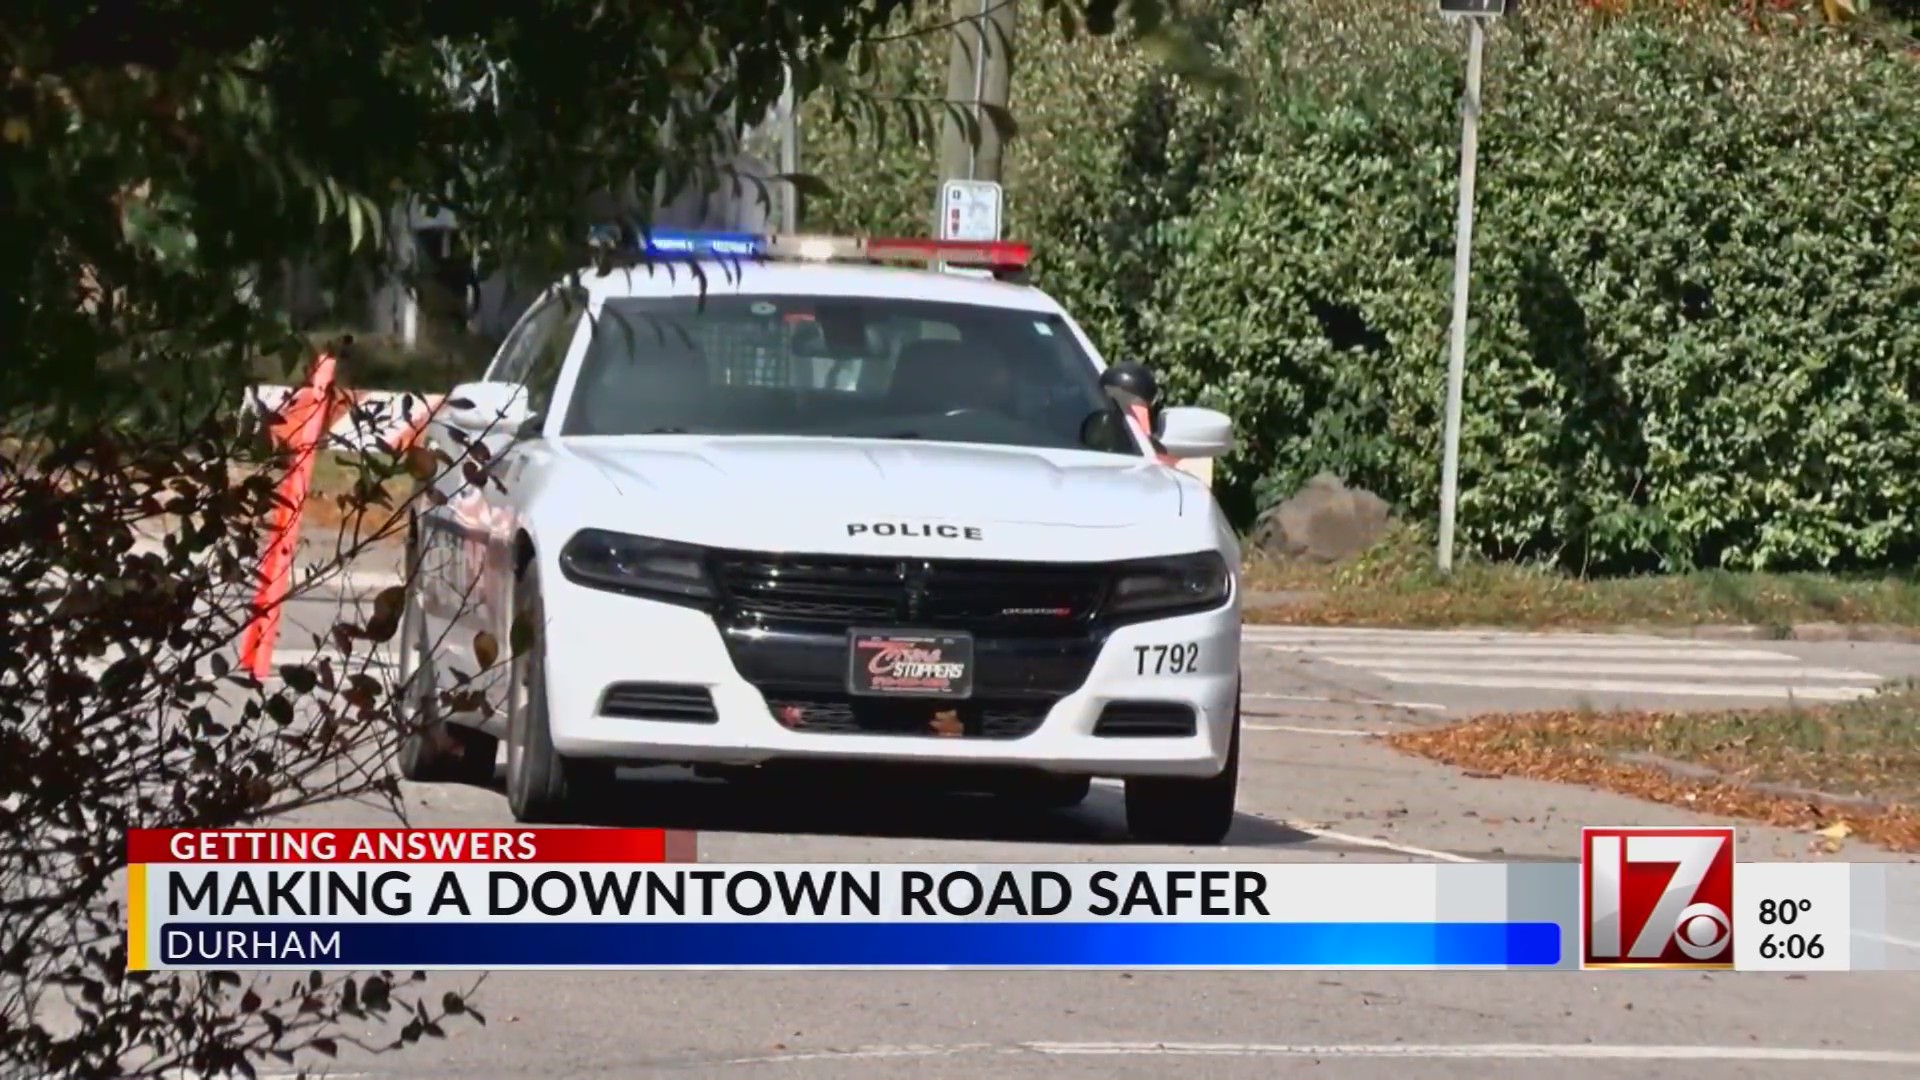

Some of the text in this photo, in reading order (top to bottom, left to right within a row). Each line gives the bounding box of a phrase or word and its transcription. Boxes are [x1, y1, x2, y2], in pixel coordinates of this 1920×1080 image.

[847, 523, 983, 541] POLICE
[1133, 642, 1200, 677] T792
[892, 661, 965, 679] STOPPERS
